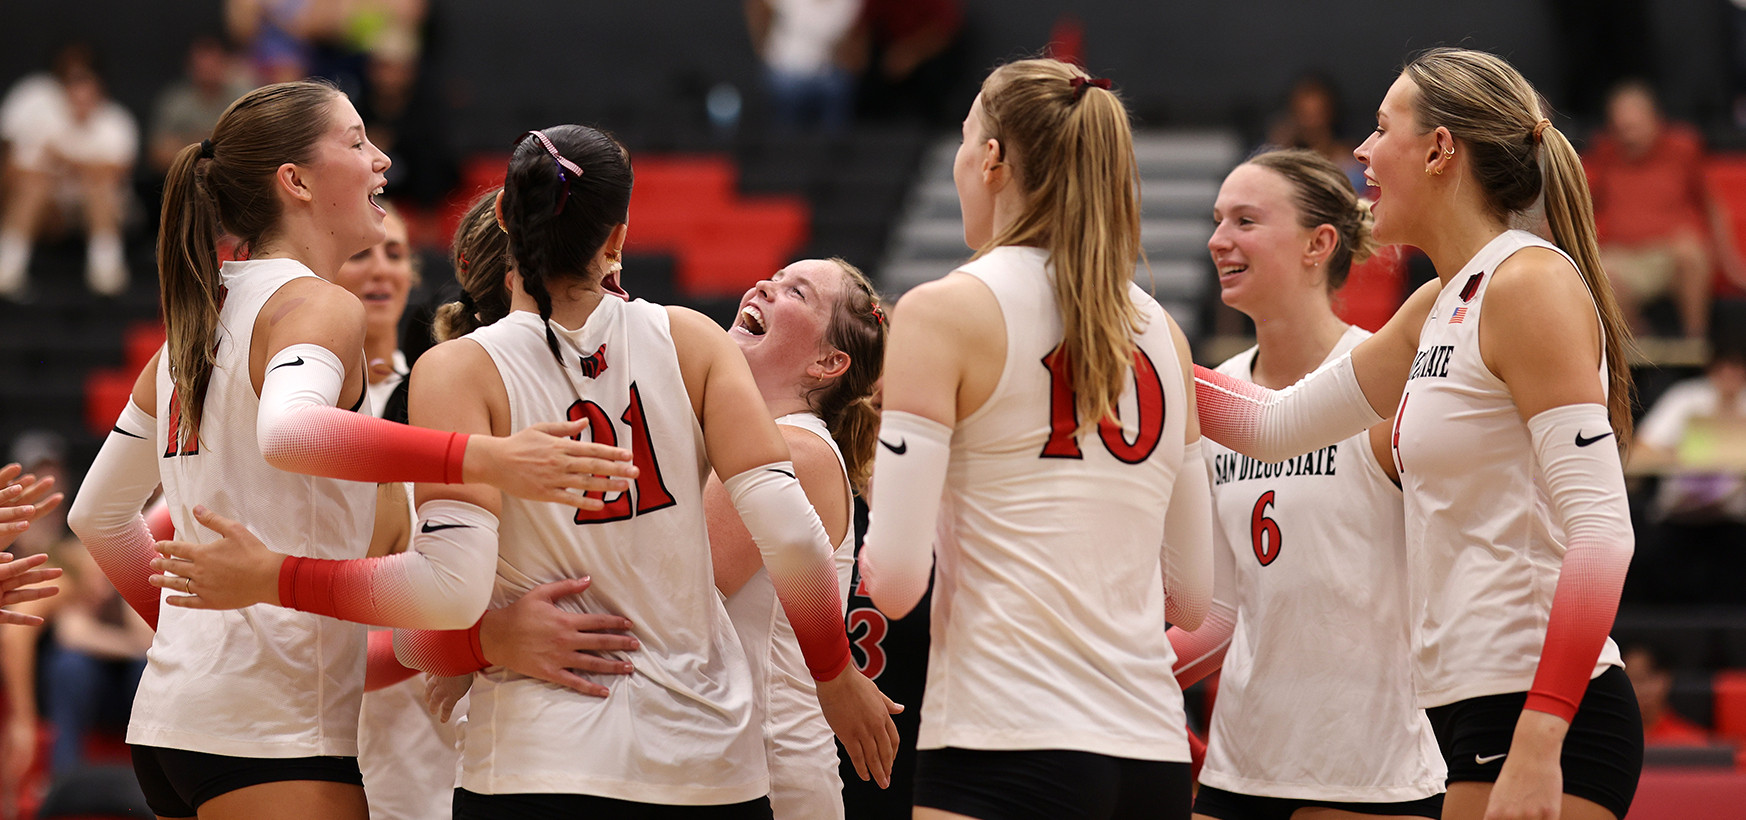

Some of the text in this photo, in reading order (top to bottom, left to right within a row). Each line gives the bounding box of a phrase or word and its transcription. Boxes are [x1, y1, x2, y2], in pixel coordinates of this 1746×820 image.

[1039, 337, 1166, 465] 10
[566, 380, 677, 526] 21
[1215, 452, 1238, 485] SAN
[1285, 445, 1338, 477] STATE
[1250, 489, 1283, 567] 6
[847, 607, 889, 681] 3
